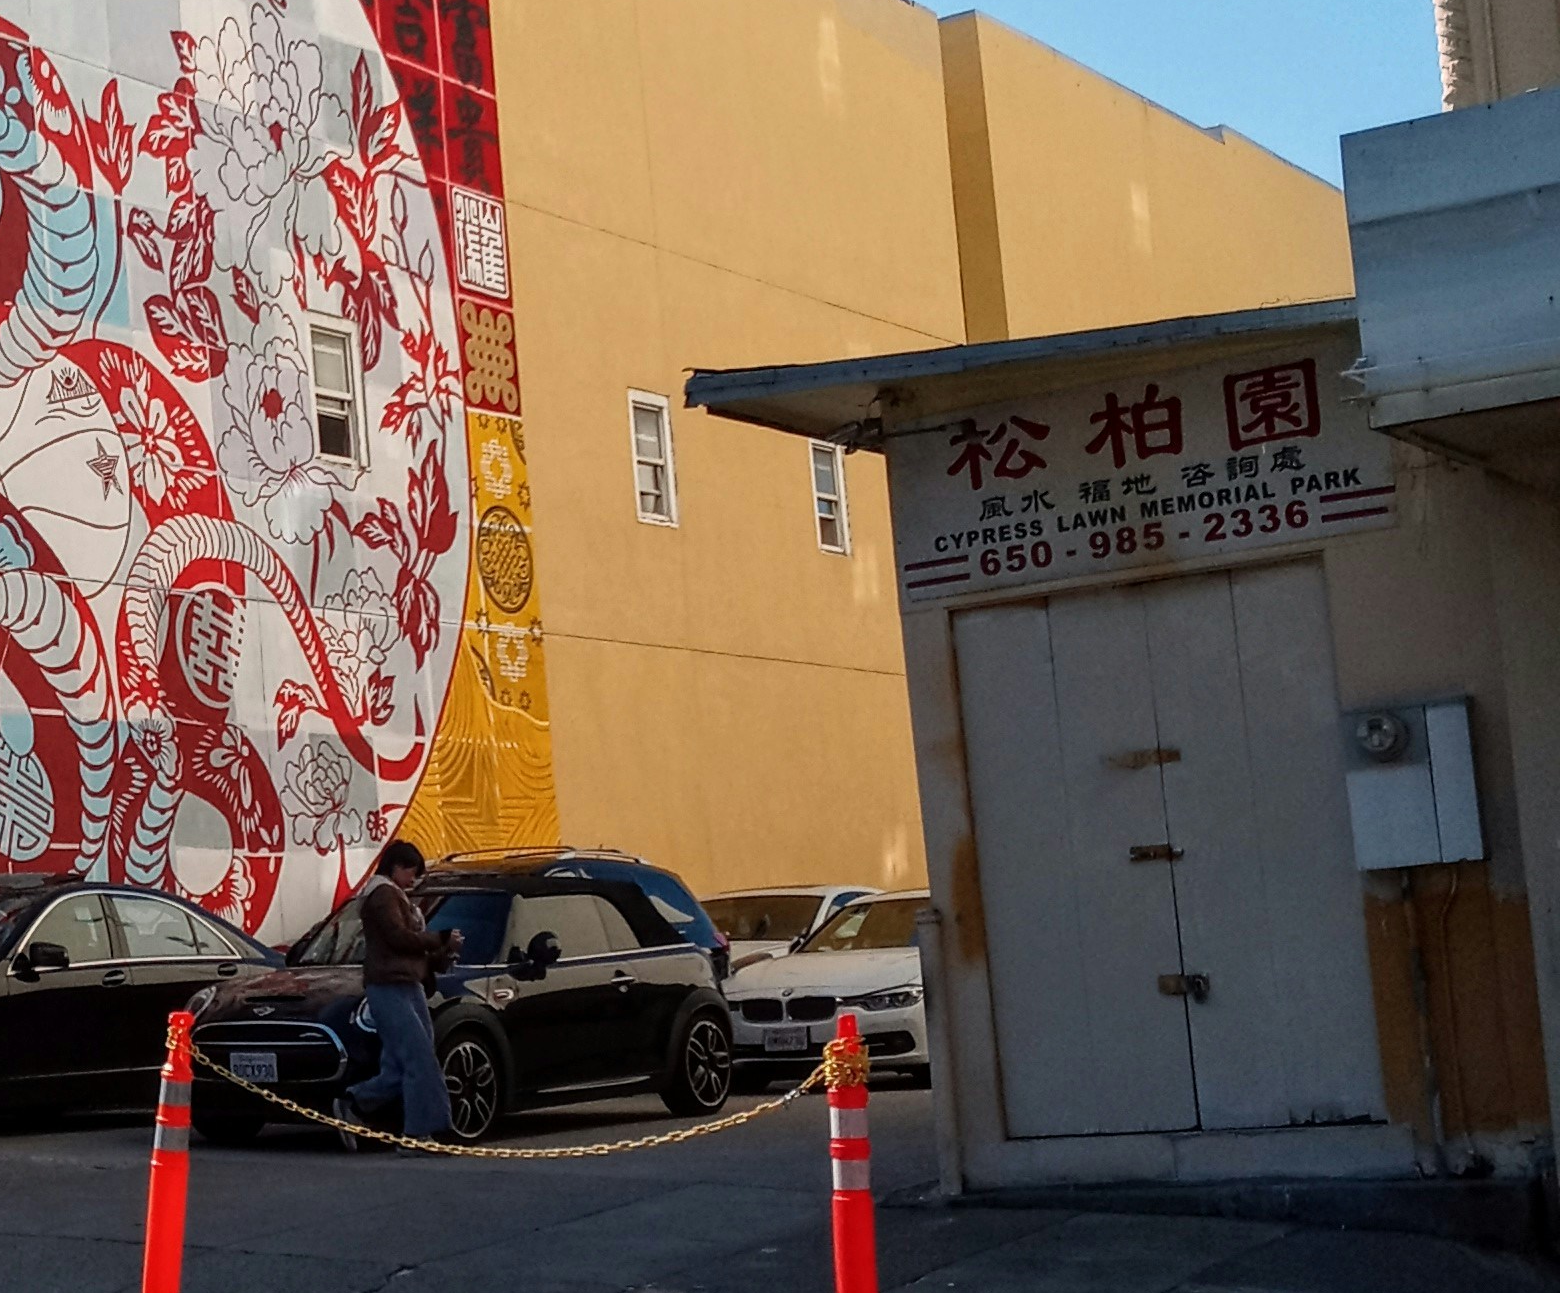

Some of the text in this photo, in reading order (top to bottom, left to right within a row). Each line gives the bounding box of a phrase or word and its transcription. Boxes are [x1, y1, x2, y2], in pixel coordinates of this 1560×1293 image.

[934, 467, 1363, 553] CYPRESS LAWN MEMORIAL PARK
[979, 540, 1053, 576] 650
[1089, 521, 1166, 560] 985
[1202, 499, 1310, 543] 2336
